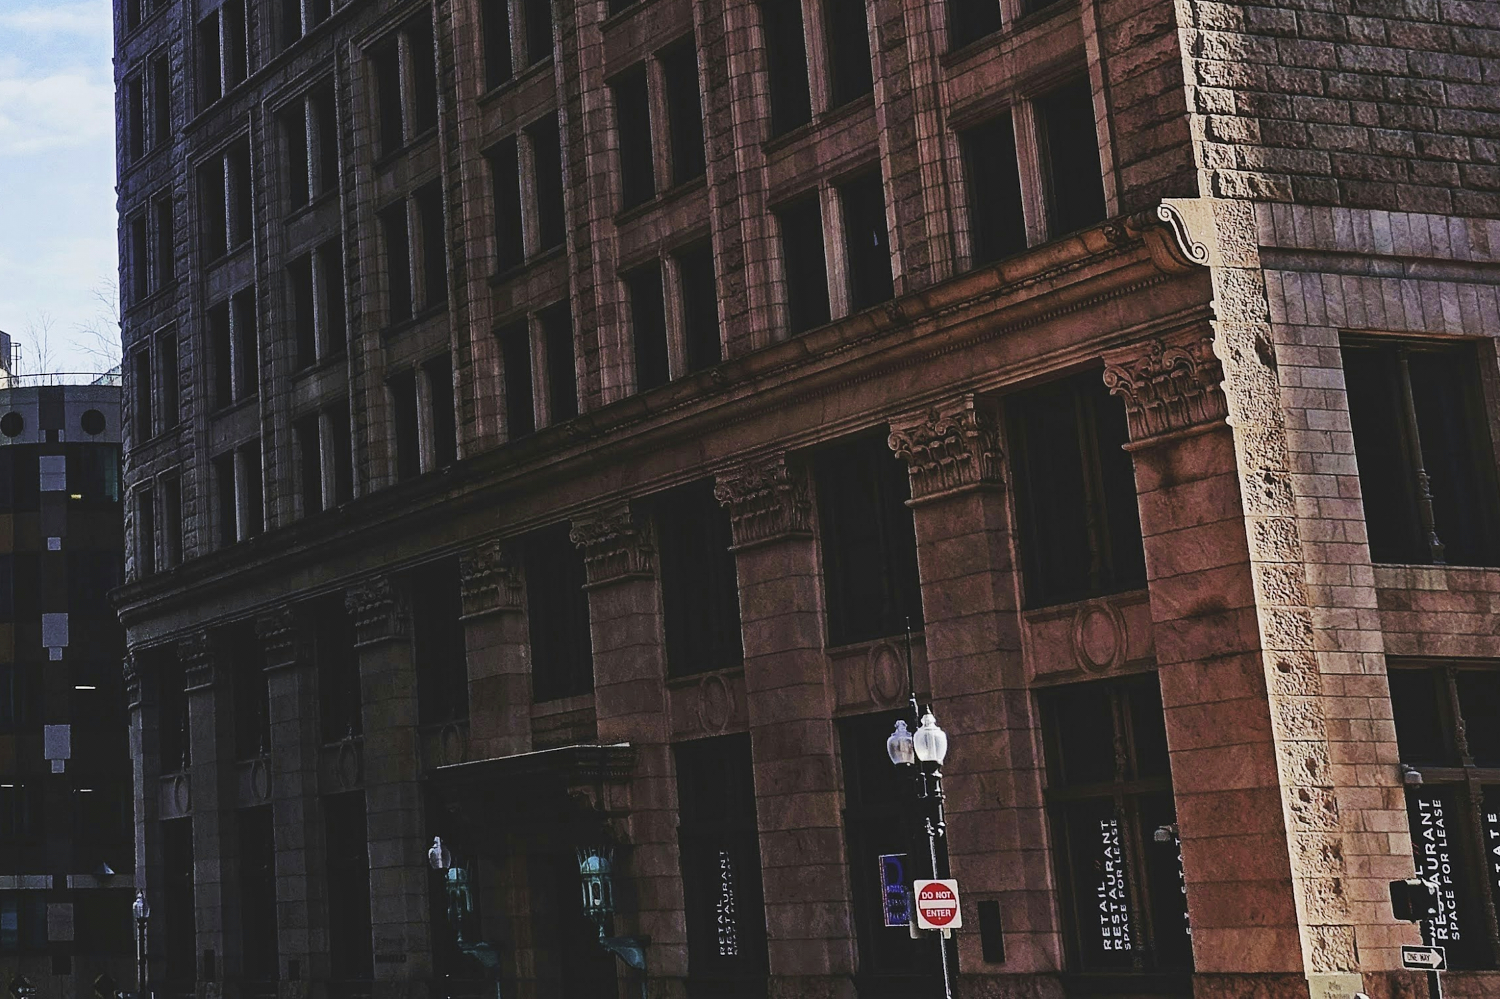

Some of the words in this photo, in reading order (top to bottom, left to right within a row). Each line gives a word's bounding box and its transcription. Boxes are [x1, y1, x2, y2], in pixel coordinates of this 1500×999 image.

[1110, 820, 1121, 863] LEASE
[1433, 800, 1447, 847] LEASE
[1100, 821, 1122, 951] RESTAURANT
[1117, 869, 1125, 898] FOR
[1441, 854, 1453, 884] FOR
[719, 850, 733, 956] RESTAURANT
[921, 891, 934, 899] DO
[936, 891, 952, 899] NOT
[926, 909, 952, 917] ENTER
[1098, 881, 1112, 951] RETAIL
[1446, 890, 1461, 941] SPACE
[717, 900, 725, 956] RETAIL
[1120, 904, 1131, 951] SPACE
[1407, 953, 1418, 961] ONE
